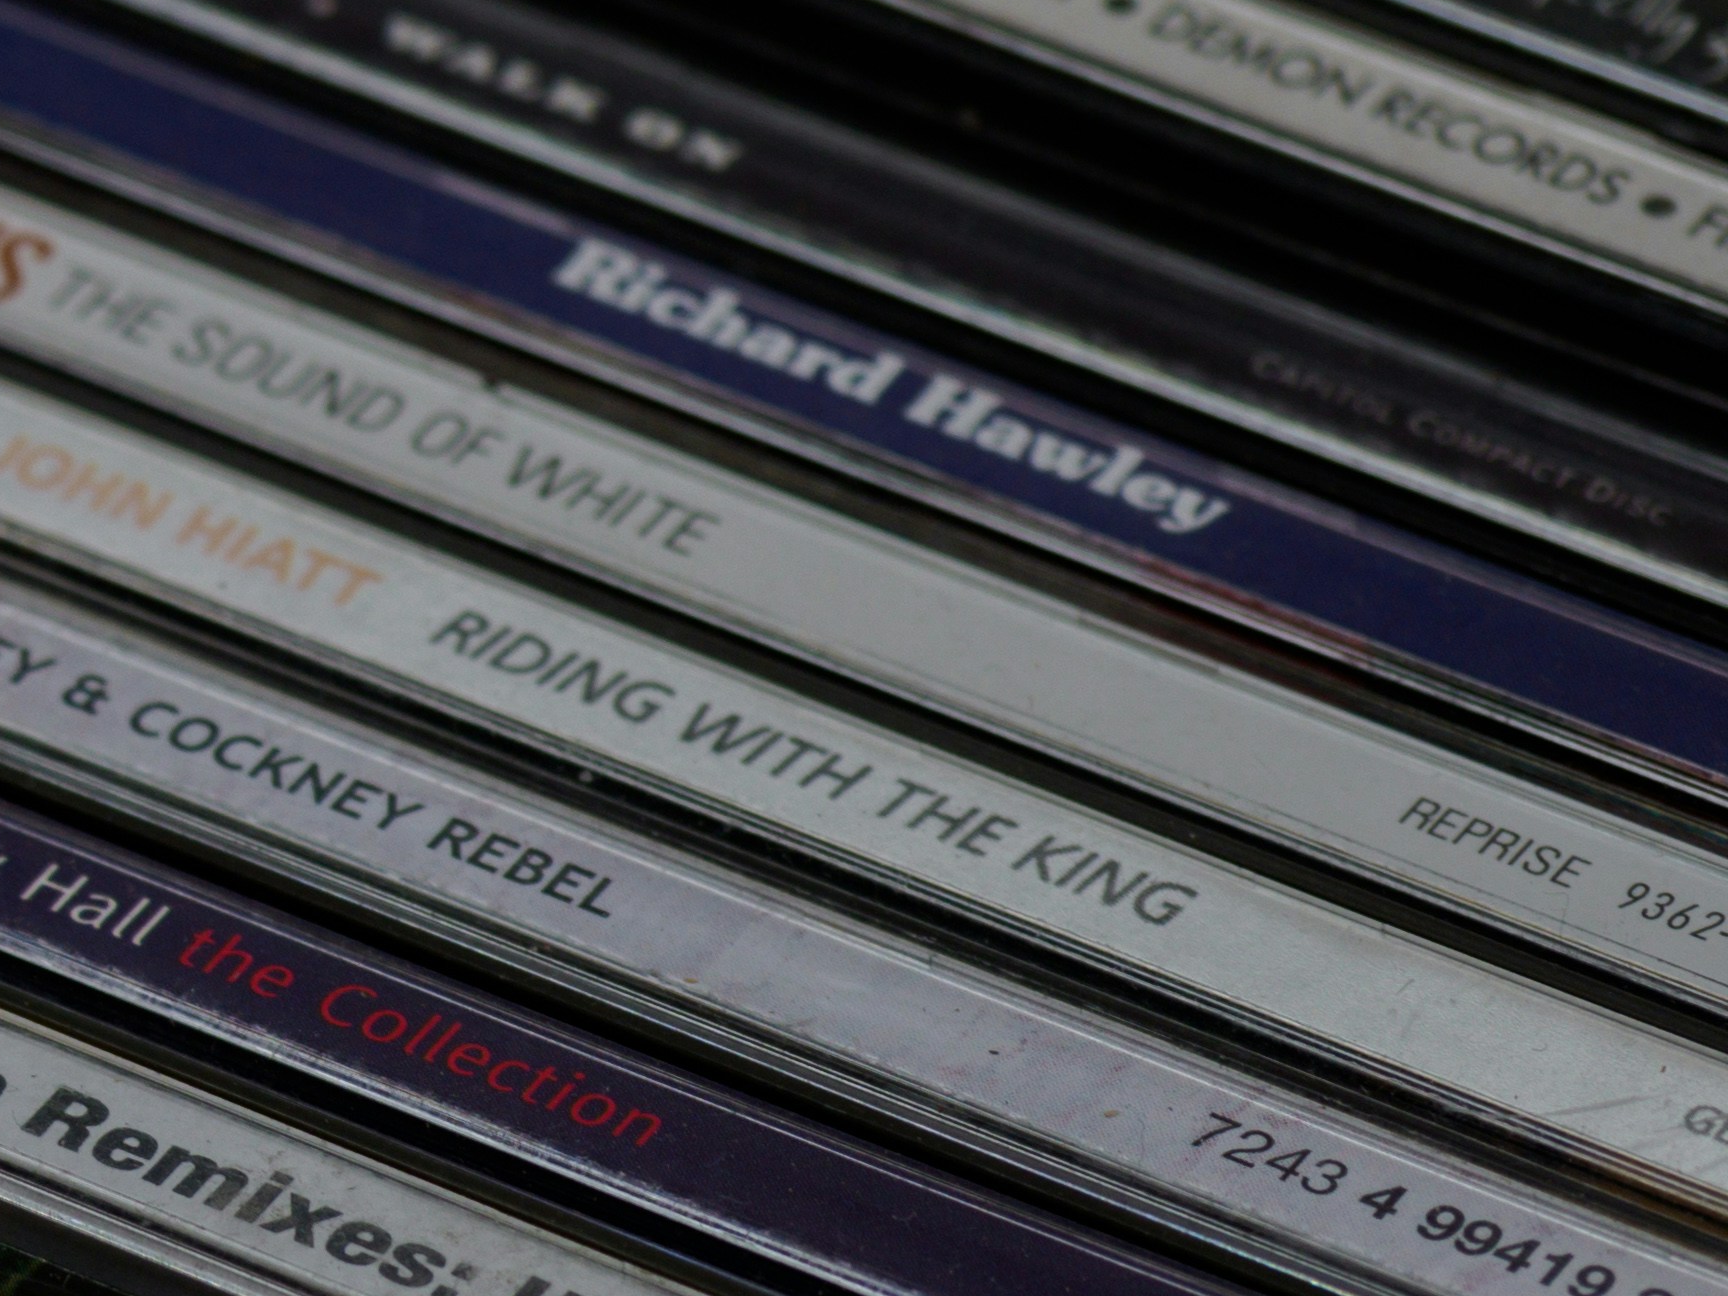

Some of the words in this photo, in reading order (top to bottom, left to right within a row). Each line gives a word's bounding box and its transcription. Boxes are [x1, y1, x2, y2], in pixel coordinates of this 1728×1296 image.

[382, 8, 611, 124] WALK
[624, 109, 742, 176] ON
[1374, 80, 1634, 211] RECORDS
[549, 237, 903, 409] Richard
[906, 368, 1234, 536] Hawley
[55, 262, 180, 348] THE
[171, 317, 405, 438] SOUND
[411, 407, 505, 473] OF
[508, 442, 723, 559] WHITE
[1399, 795, 1592, 893] REPRISE
[176, 508, 387, 610] HIATT
[430, 606, 676, 727] RIDING
[680, 700, 872, 801] WITH
[874, 775, 1019, 858] THE
[1011, 830, 1199, 932] KING
[19, 862, 173, 947] Hall
[176, 927, 298, 999] the
[319, 983, 665, 1149] Collection
[59, 672, 122, 717] &
[126, 698, 424, 831] COCKNEY
[422, 815, 618, 921] REBEL
[1189, 1111, 1350, 1196] 7243
[1358, 1185, 1409, 1221] 4
